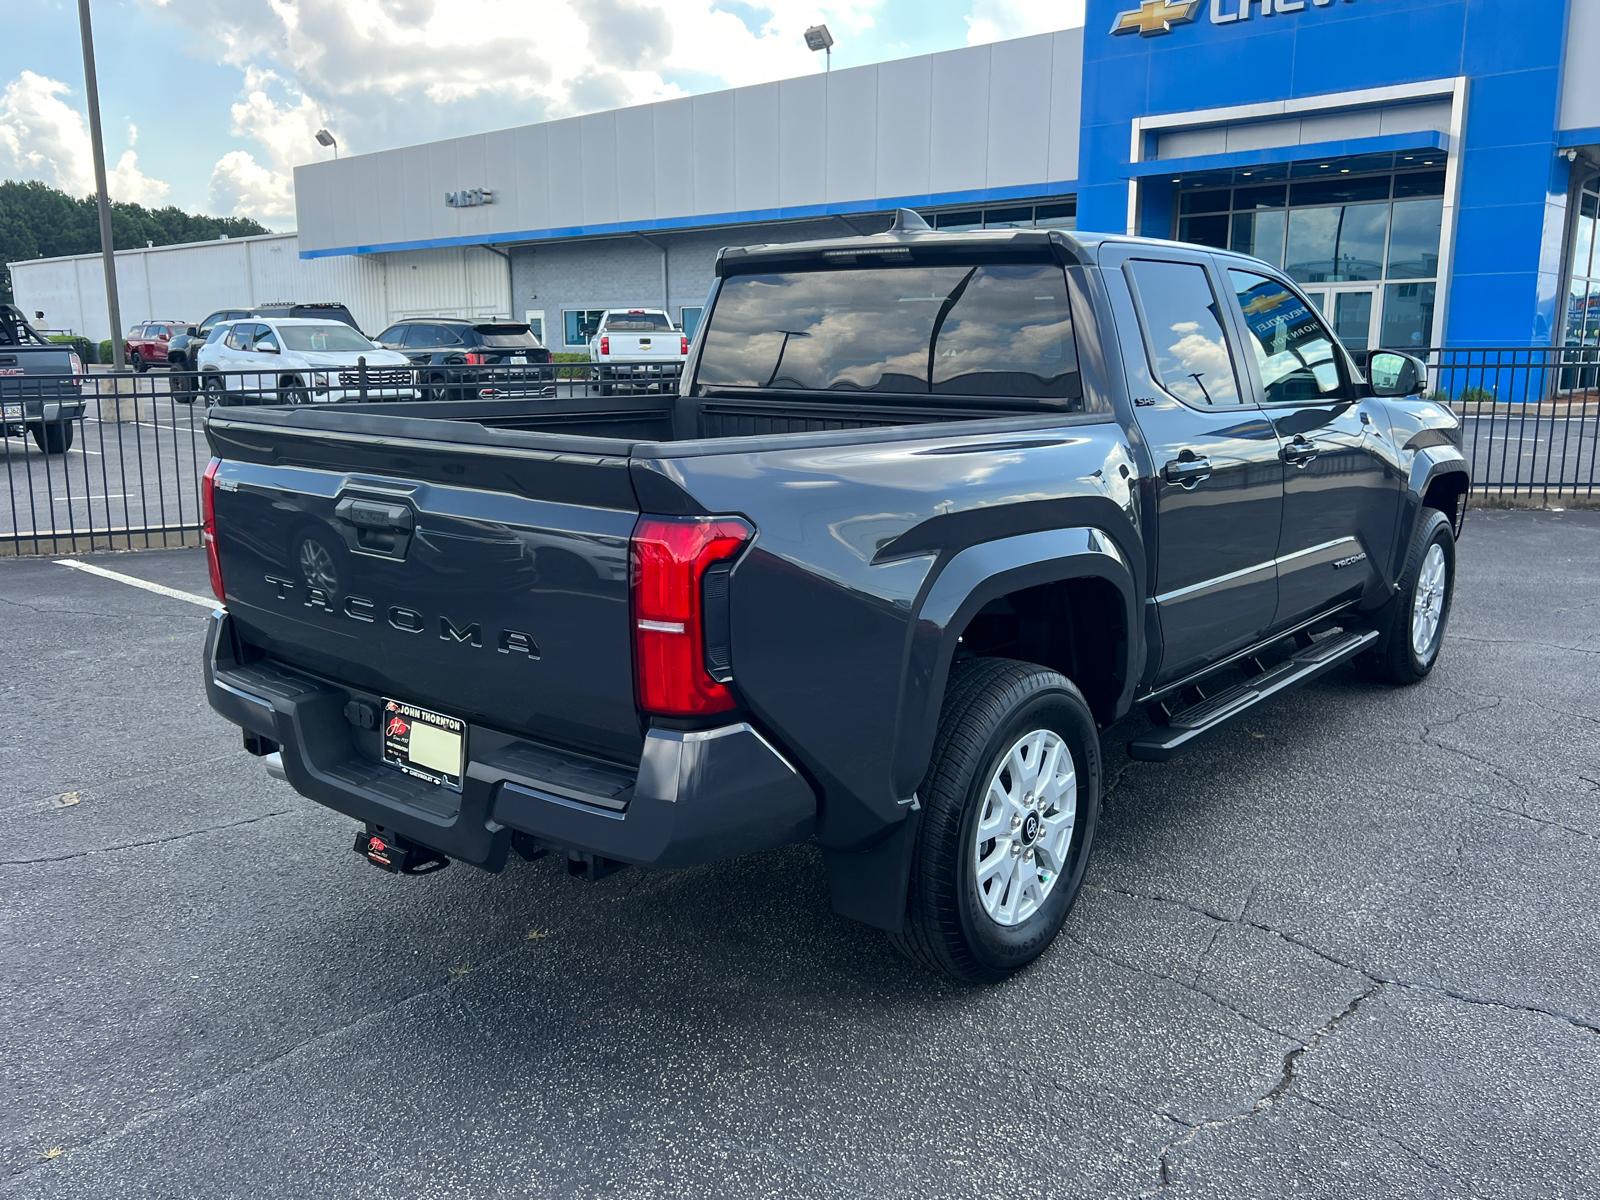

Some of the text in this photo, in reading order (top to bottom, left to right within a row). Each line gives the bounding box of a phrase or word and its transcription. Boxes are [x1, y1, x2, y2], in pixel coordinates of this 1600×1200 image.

[445, 188, 487, 207] PARTS
[1333, 552, 1367, 569] TACOMA
[264, 575, 541, 661] TACOMA
[400, 705, 421, 719] JOHN
[421, 712, 460, 731] THORNTON
